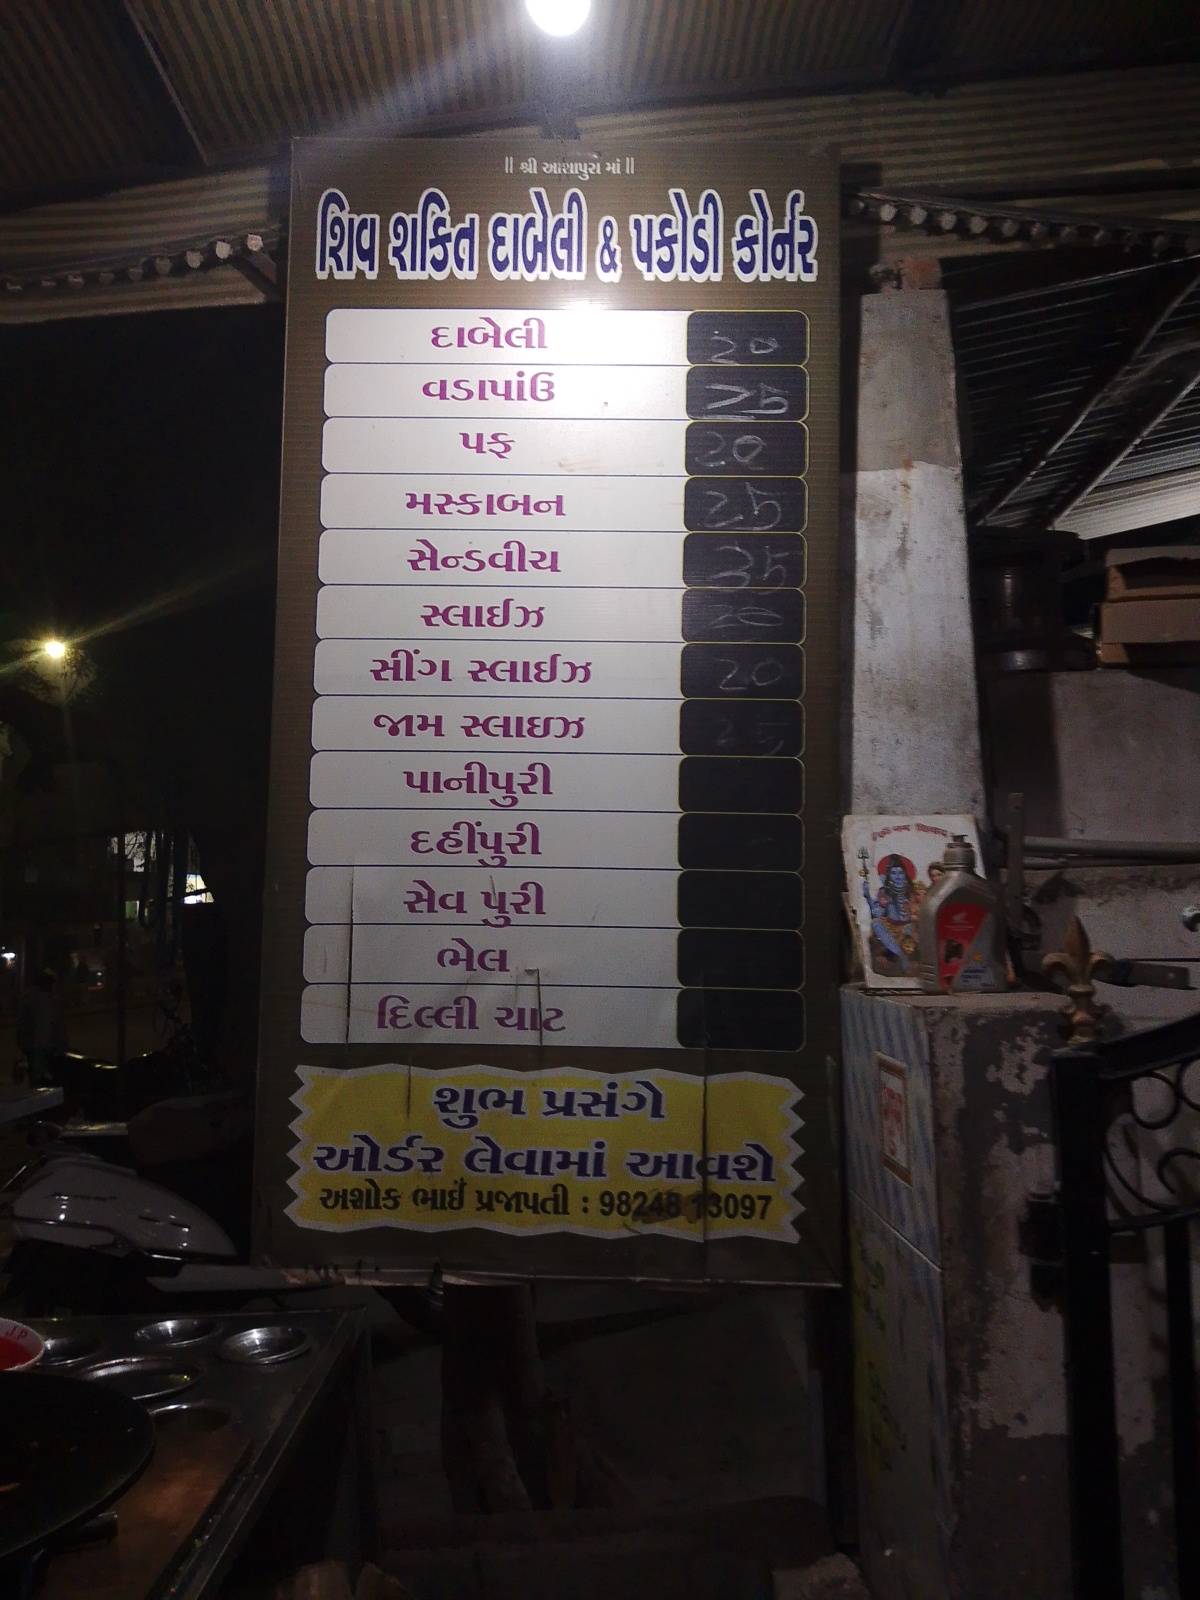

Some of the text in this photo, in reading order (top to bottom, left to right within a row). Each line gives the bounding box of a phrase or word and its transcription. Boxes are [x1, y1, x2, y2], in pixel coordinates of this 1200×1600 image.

[519, 157, 538, 174] શ્રી
[605, 157, 621, 175] માં
[317, 188, 379, 279] શિવ
[488, 188, 587, 280] દાબેલી
[597, 216, 622, 282] &
[630, 189, 723, 282] પકોડી
[733, 190, 818, 282] કોર્નર
[431, 317, 548, 349] દાબેલી
[422, 370, 555, 402] વડાપાંઉ
[459, 431, 515, 460] પફ
[405, 492, 566, 517] મસ્કાબન
[406, 539, 561, 573] સેન્ડવીચ
[420, 598, 545, 628] સ્લાઈઝ
[369, 648, 592, 684] સીંગ સ્લાઈઝ
[373, 714, 445, 737] જામ
[403, 761, 553, 808] પાનીપુરી
[410, 820, 542, 868] દહીંપુરી
[403, 879, 546, 928] સેવ પુરી
[436, 937, 510, 973] ભેલ
[376, 994, 567, 1032] દિલ્લી ચાટ
[434, 1081, 665, 1129] શુભ પ્રસંગે
[313, 1134, 776, 1181] ઓર્ડર લેવામાં આવશે
[319, 1178, 401, 1211] અશોક
[476, 1183, 570, 1215] પ્રજાપતી
[599, 1190, 681, 1217] 98248
